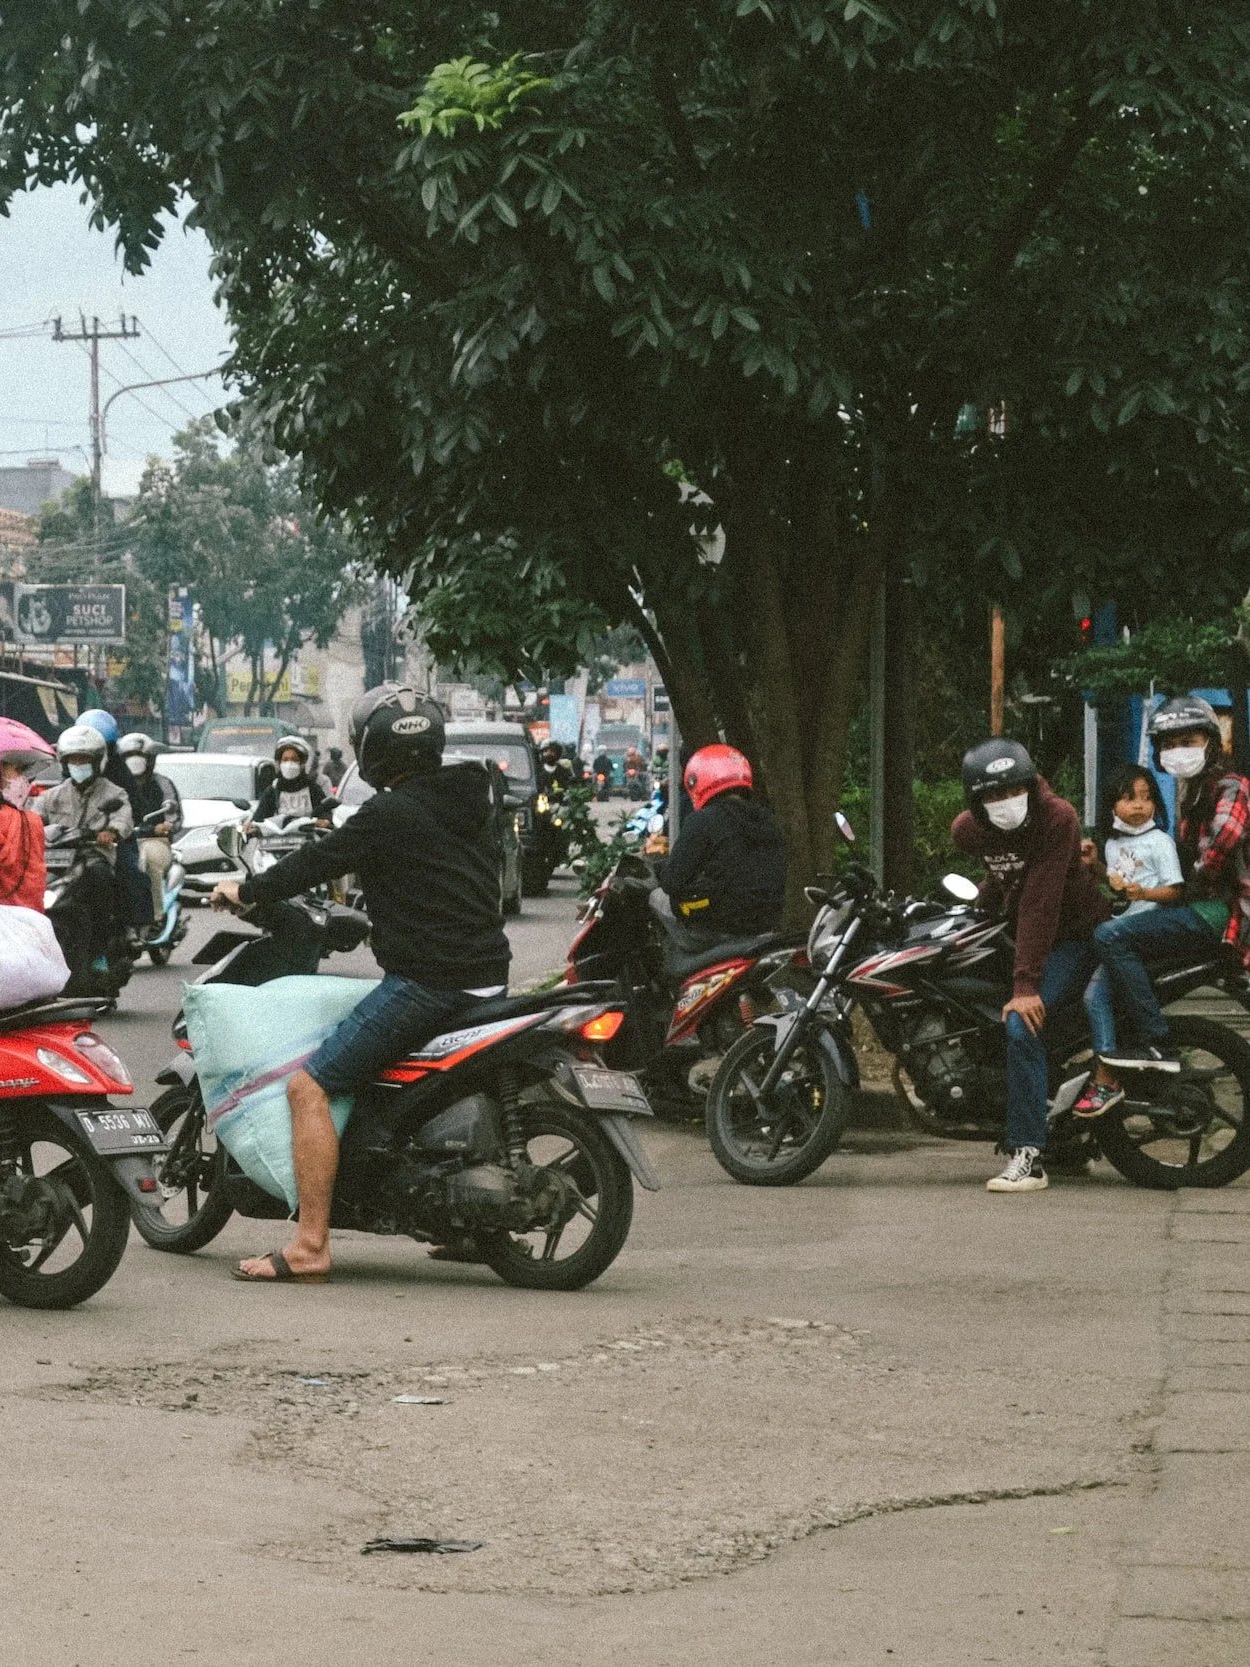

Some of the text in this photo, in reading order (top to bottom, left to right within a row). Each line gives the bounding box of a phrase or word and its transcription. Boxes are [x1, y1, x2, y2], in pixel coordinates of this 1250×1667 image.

[73, 604, 107, 616] SUCI
[66, 616, 114, 627] PETSHOP
[83, 1116, 95, 1133] D
[97, 1113, 131, 1131] 5536
